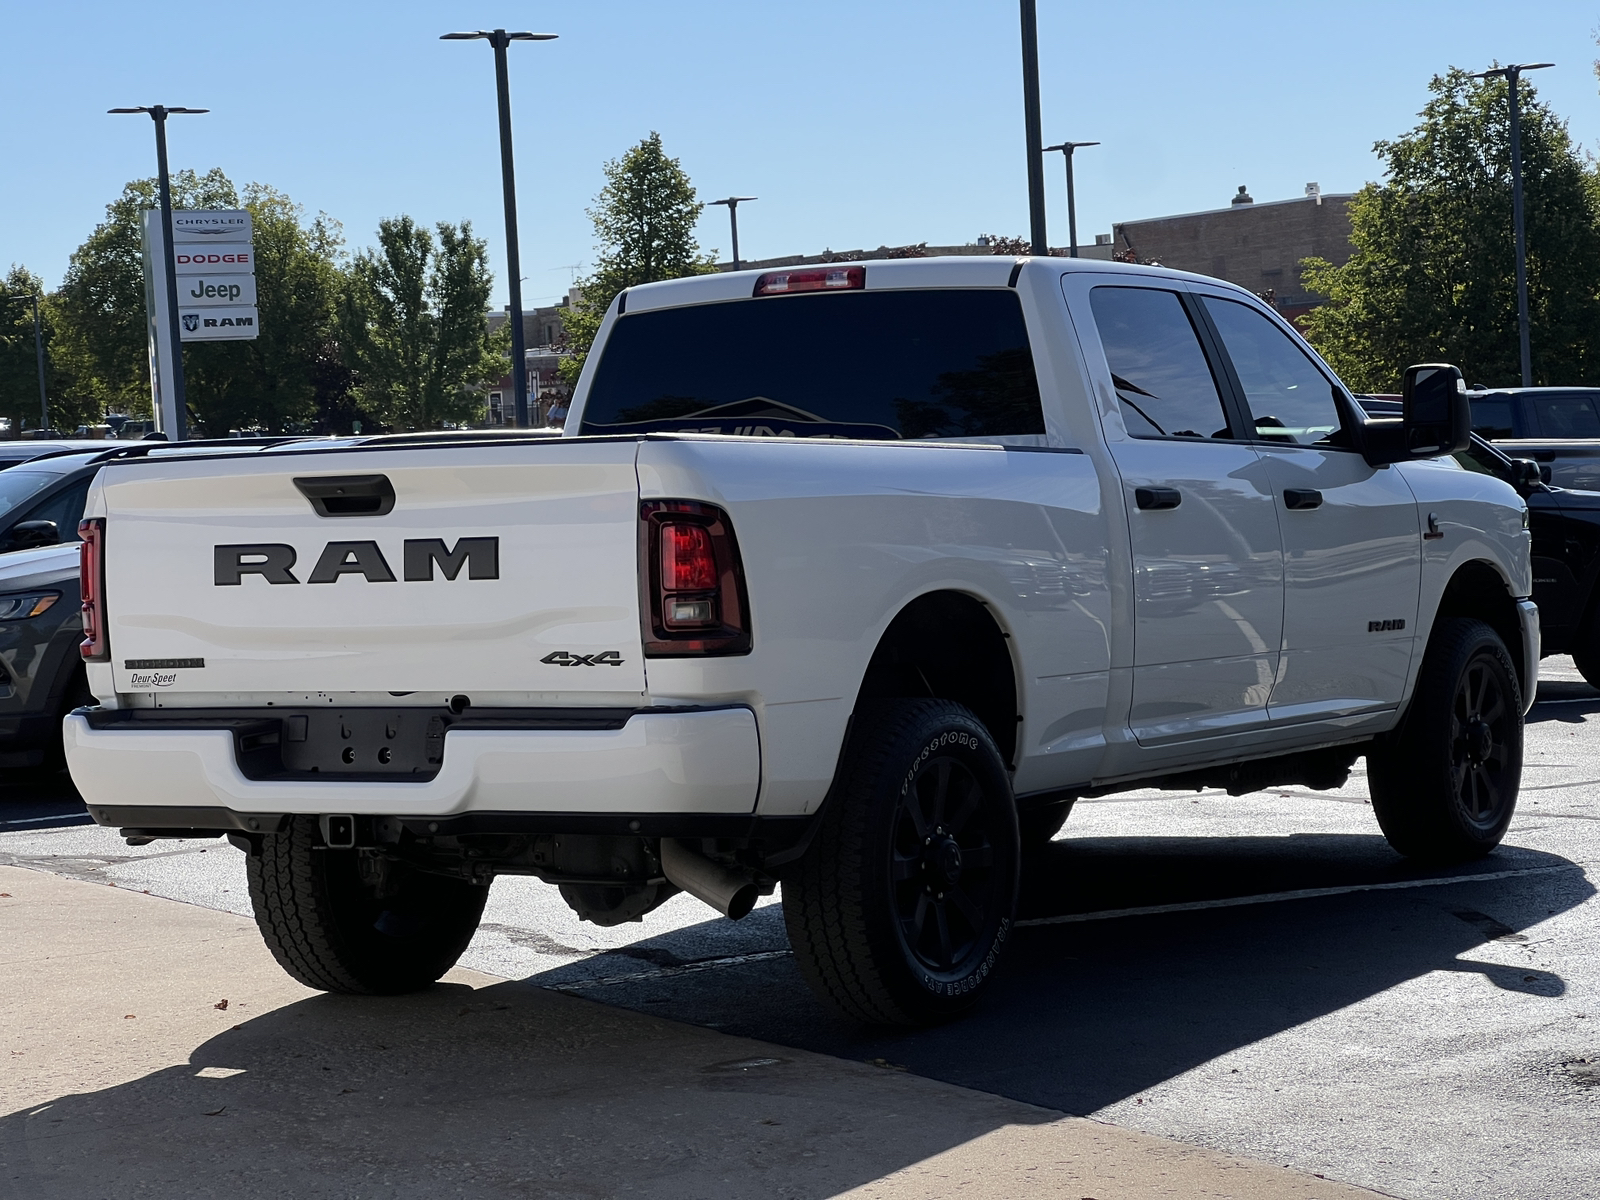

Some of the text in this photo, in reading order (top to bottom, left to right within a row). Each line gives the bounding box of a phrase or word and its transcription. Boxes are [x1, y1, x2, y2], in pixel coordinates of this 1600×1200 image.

[177, 254, 249, 264] DODGE
[190, 280, 241, 301] Jeep
[203, 317, 253, 328] RAM
[214, 536, 500, 586] RAM
[1368, 618, 1406, 632] RAM
[540, 651, 625, 666] 4x4
[131, 672, 176, 685] Deur Speet
[947, 917, 1010, 996] TRANSFORCE
